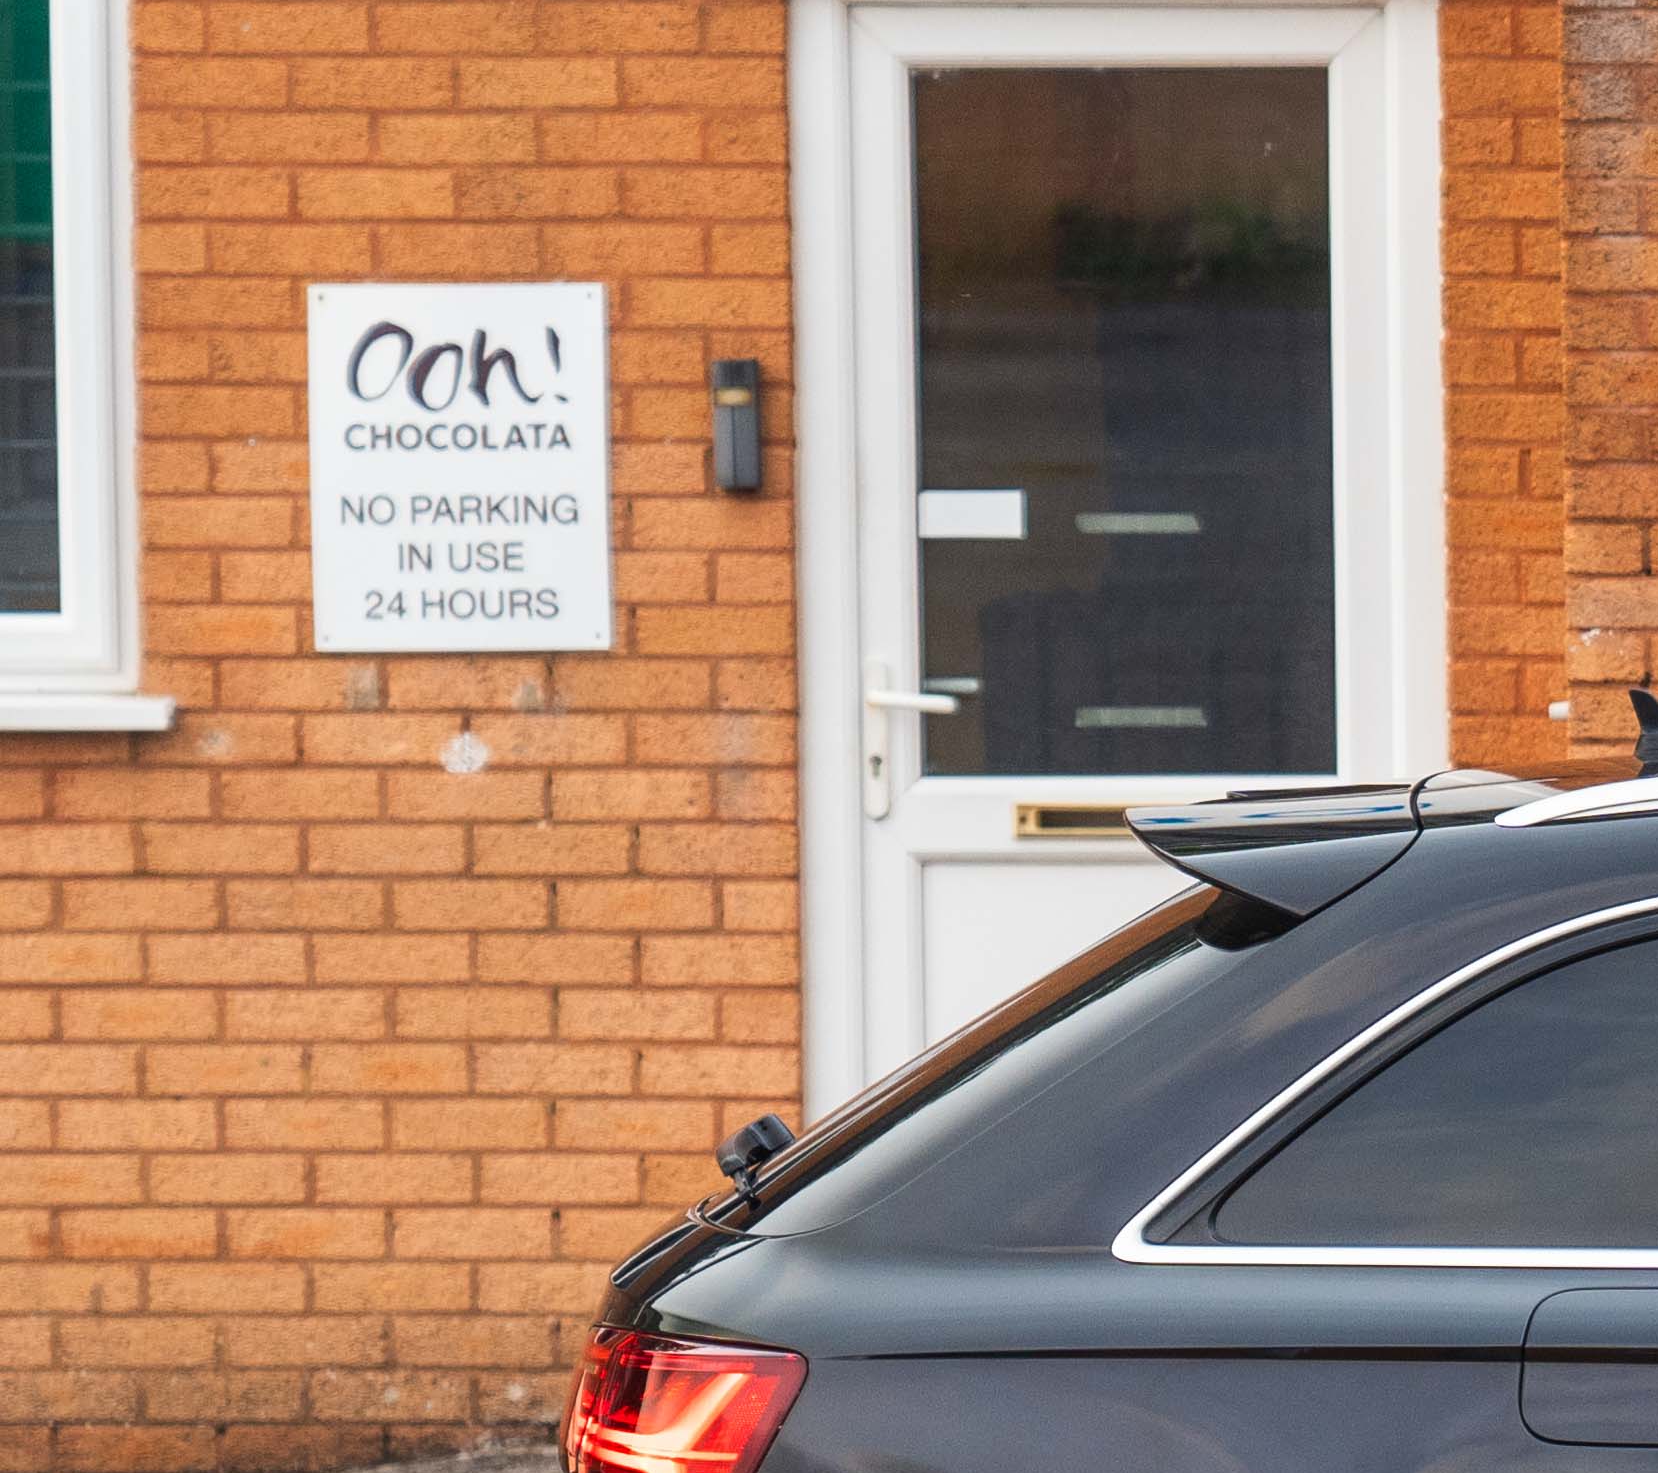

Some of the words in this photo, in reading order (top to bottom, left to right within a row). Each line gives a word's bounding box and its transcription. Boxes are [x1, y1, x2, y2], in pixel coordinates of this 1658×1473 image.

[346, 320, 570, 412] Ooh!
[344, 423, 571, 451] CHOCOLATA
[340, 494, 396, 525] NO
[410, 494, 579, 525] PARKING
[398, 542, 433, 572] IN
[448, 542, 524, 573] USE
[364, 590, 407, 620] 24
[421, 589, 560, 620] HOURS
